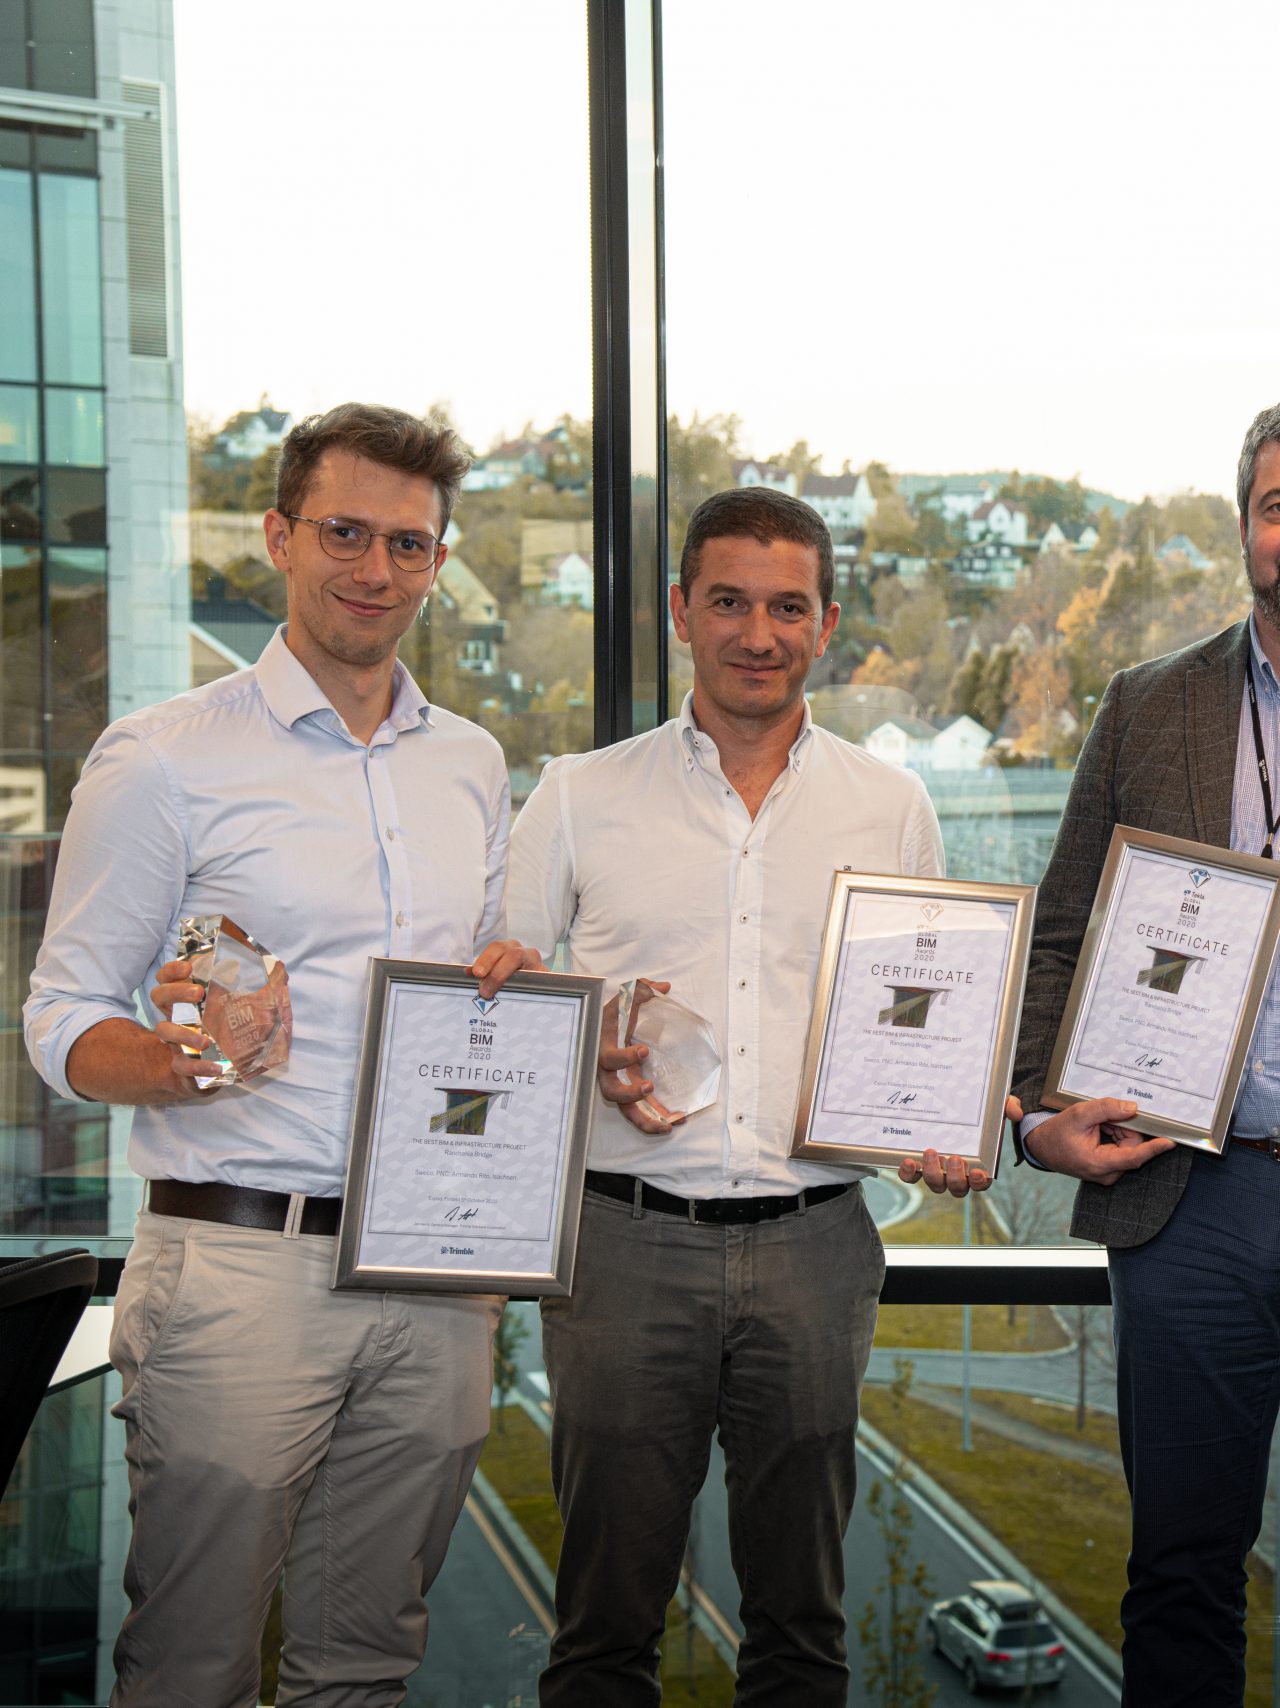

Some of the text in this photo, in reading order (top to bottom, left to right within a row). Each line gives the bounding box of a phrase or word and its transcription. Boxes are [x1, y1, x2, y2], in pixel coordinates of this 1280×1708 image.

[1192, 892, 1205, 900] Tekla
[1180, 902, 1200, 915] BIM
[1178, 919, 1196, 928] 2020
[916, 938, 937, 948] BIM
[1136, 923, 1230, 956] CERTIFICATE
[871, 964, 974, 983] CERTIFICATE
[228, 1006, 254, 1030] BIM
[480, 1020, 496, 1028] Tekla
[470, 1034, 493, 1045] BIM
[468, 1052, 491, 1060] 2020
[418, 1064, 536, 1084] CERTIFICATE
[1134, 1089, 1153, 1099] Trimble
[455, 1140, 501, 1149] INFRASTRUCTURE
[449, 1247, 474, 1255] Trimble
